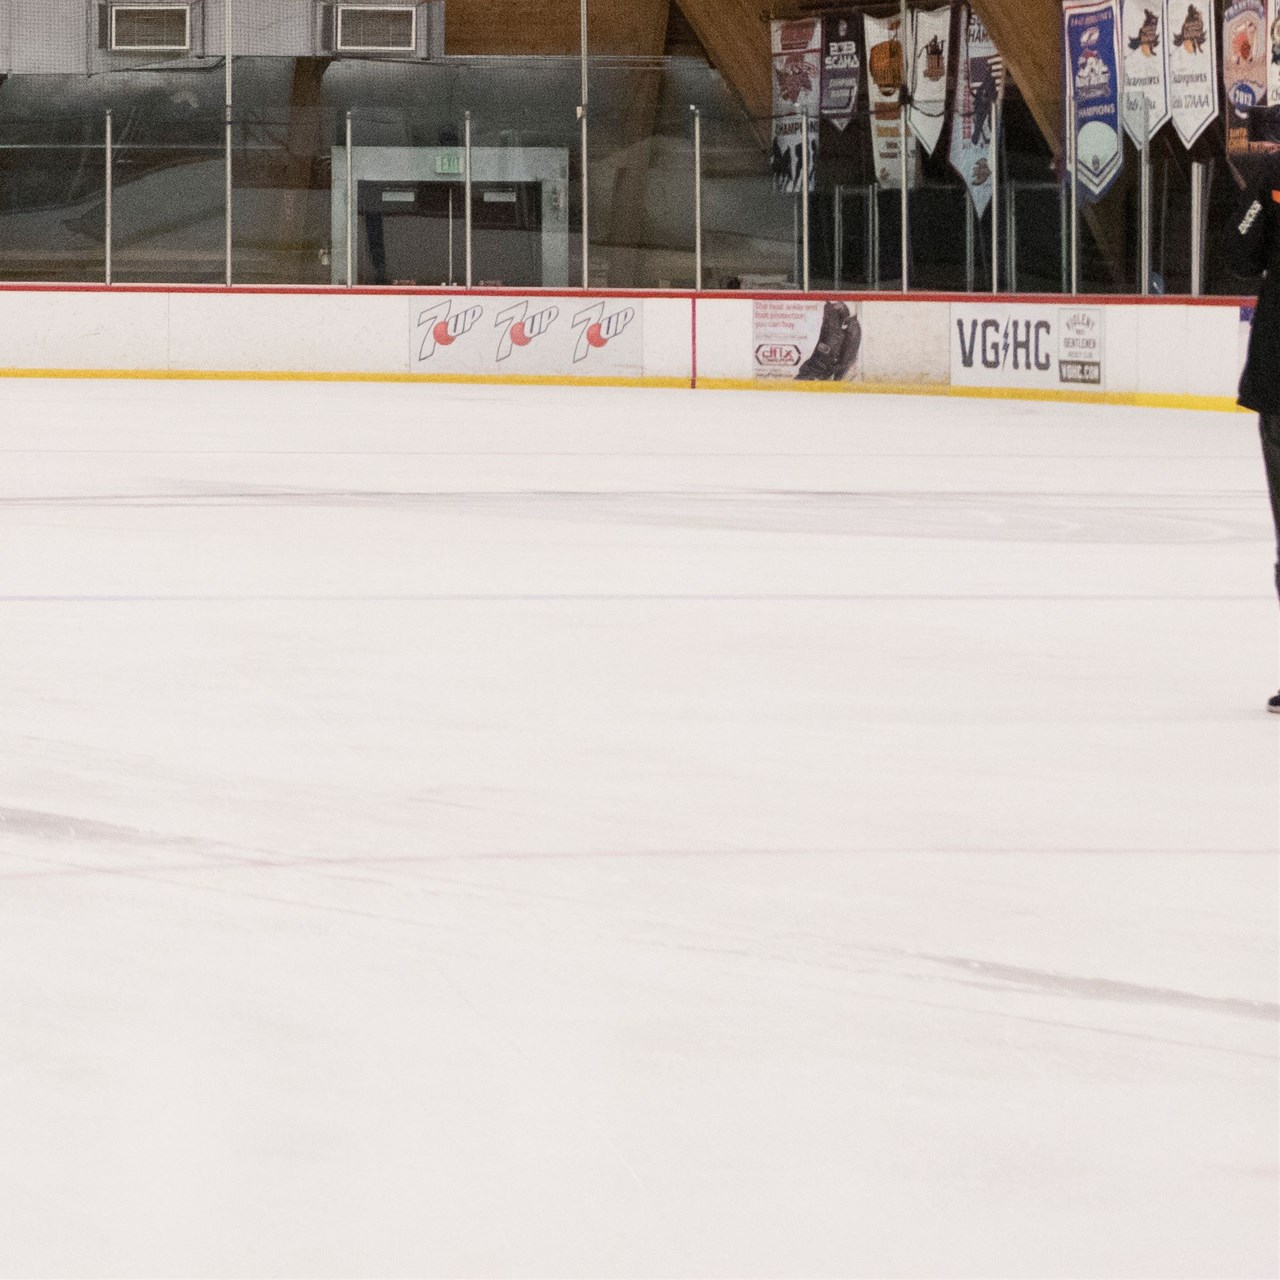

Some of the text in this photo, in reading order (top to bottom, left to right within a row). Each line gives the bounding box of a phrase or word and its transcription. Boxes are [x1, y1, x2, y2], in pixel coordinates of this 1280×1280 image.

[1066, 313, 1095, 331] VIOLENT
[1064, 337, 1096, 348] GENTLEMEN
[1061, 364, 1099, 381] VGHC.COM
